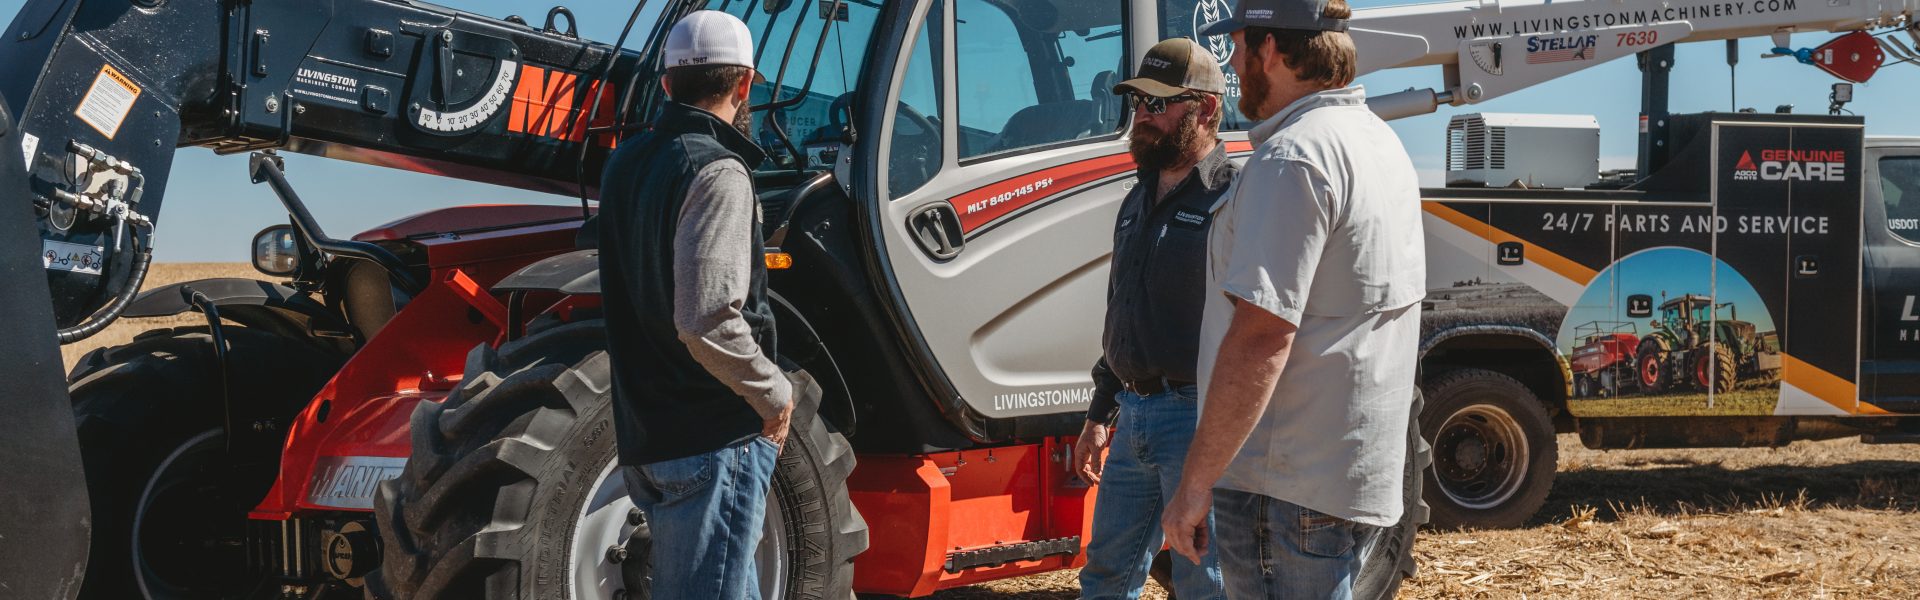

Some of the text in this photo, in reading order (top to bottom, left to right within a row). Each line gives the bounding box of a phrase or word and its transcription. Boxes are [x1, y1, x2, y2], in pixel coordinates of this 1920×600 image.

[1453, 0, 1797, 39] WWW.LIVINGSTONMACHINERY.COM
[1616, 30, 1657, 47] 7630
[111, 72, 138, 94] WARNING
[296, 76, 357, 93] MACHINERY COMPANY
[297, 68, 358, 87] LIVINGSTON
[1761, 149, 1845, 162] GENUINE
[1760, 161, 1845, 181] CARE
[967, 177, 1054, 215] MLT 840-145 PS+
[1541, 212, 1829, 234] 24/7 PARTS AND SERVICE
[1888, 218, 1919, 230] USDOT
